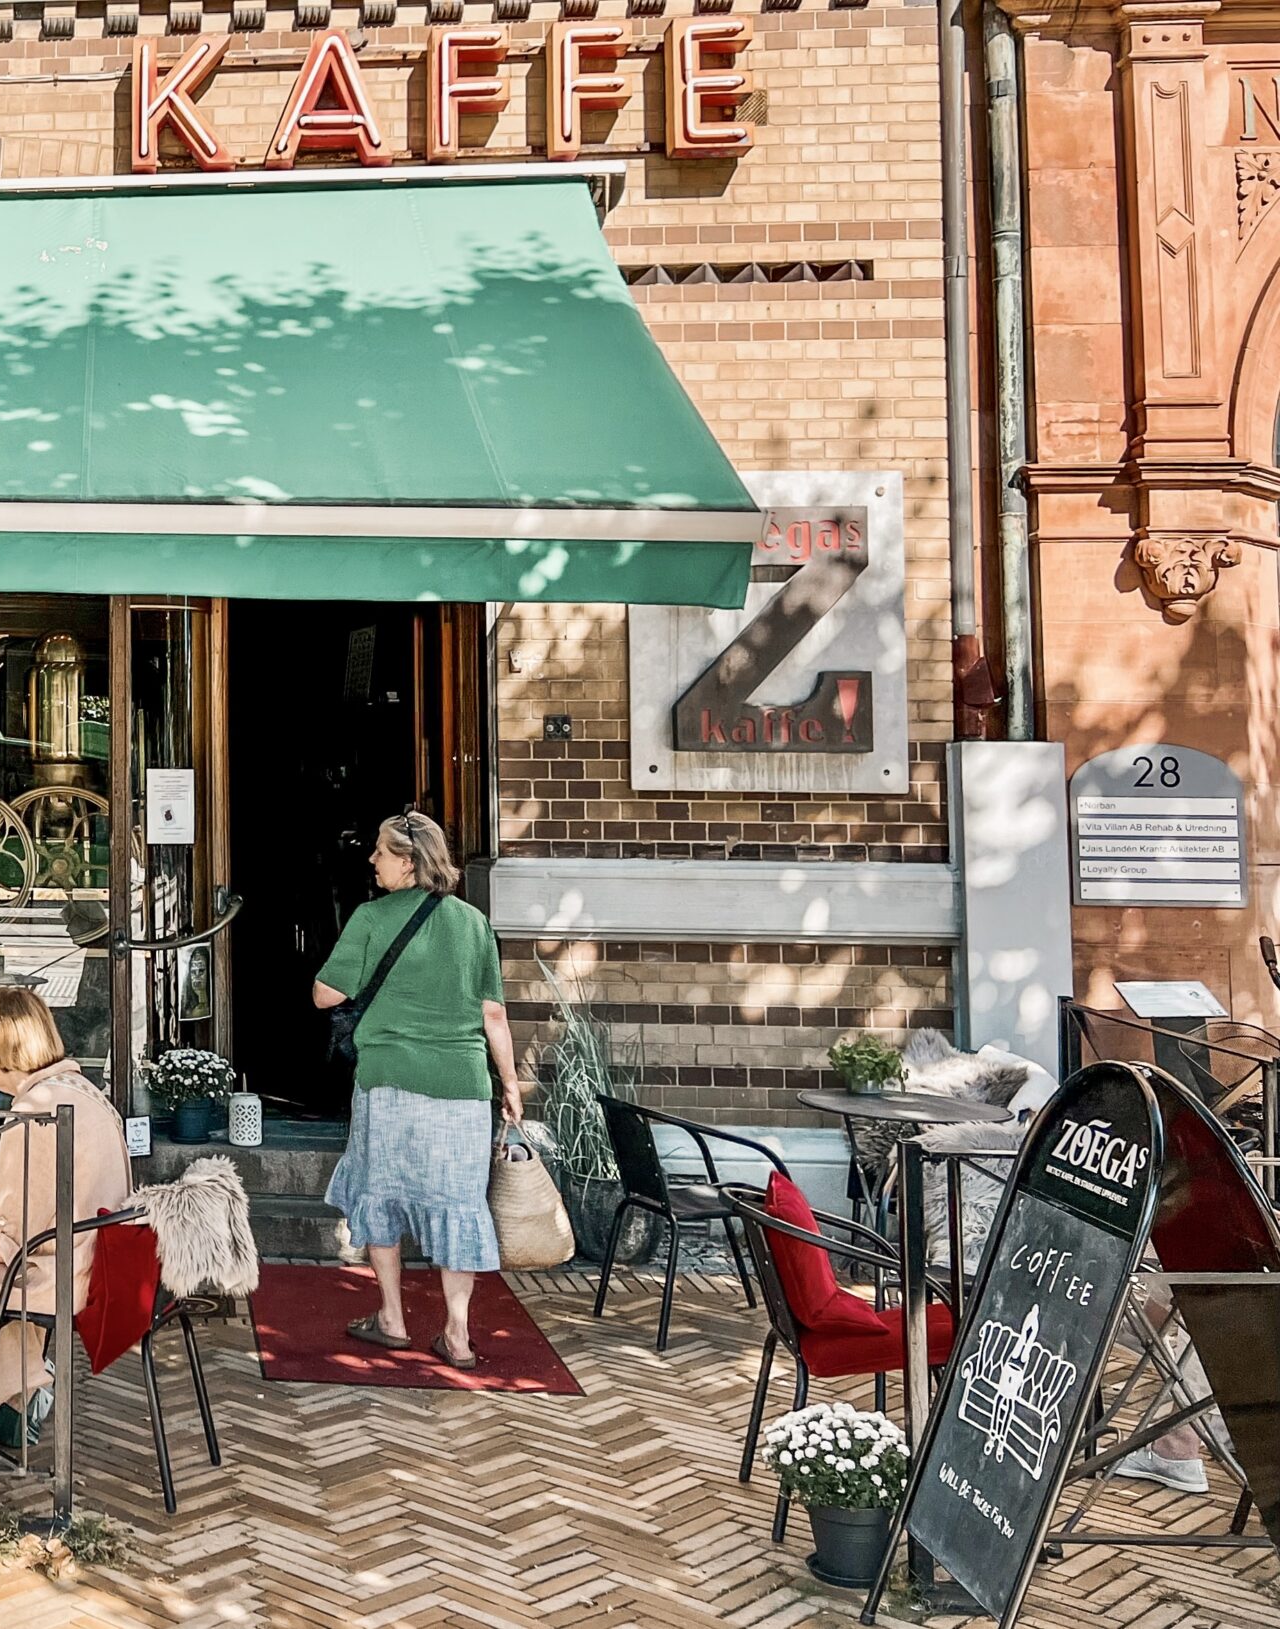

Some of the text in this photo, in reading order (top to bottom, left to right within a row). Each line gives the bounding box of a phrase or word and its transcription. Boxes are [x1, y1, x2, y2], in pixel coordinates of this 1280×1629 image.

[131, 15, 754, 174] KAFFE
[1132, 755, 1181, 788] 28
[1083, 801, 1117, 811] Norban
[1085, 823, 1227, 834] Vita Villan AB Rehab & Utredning
[1105, 844, 1138, 853] Landén
[1169, 845, 1210, 854] Arkitekter
[1211, 845, 1225, 854] AB
[1086, 865, 1148, 875] Loyalty Group
[938, 1461, 1016, 1539] WILL BE THERE FOR YOU
